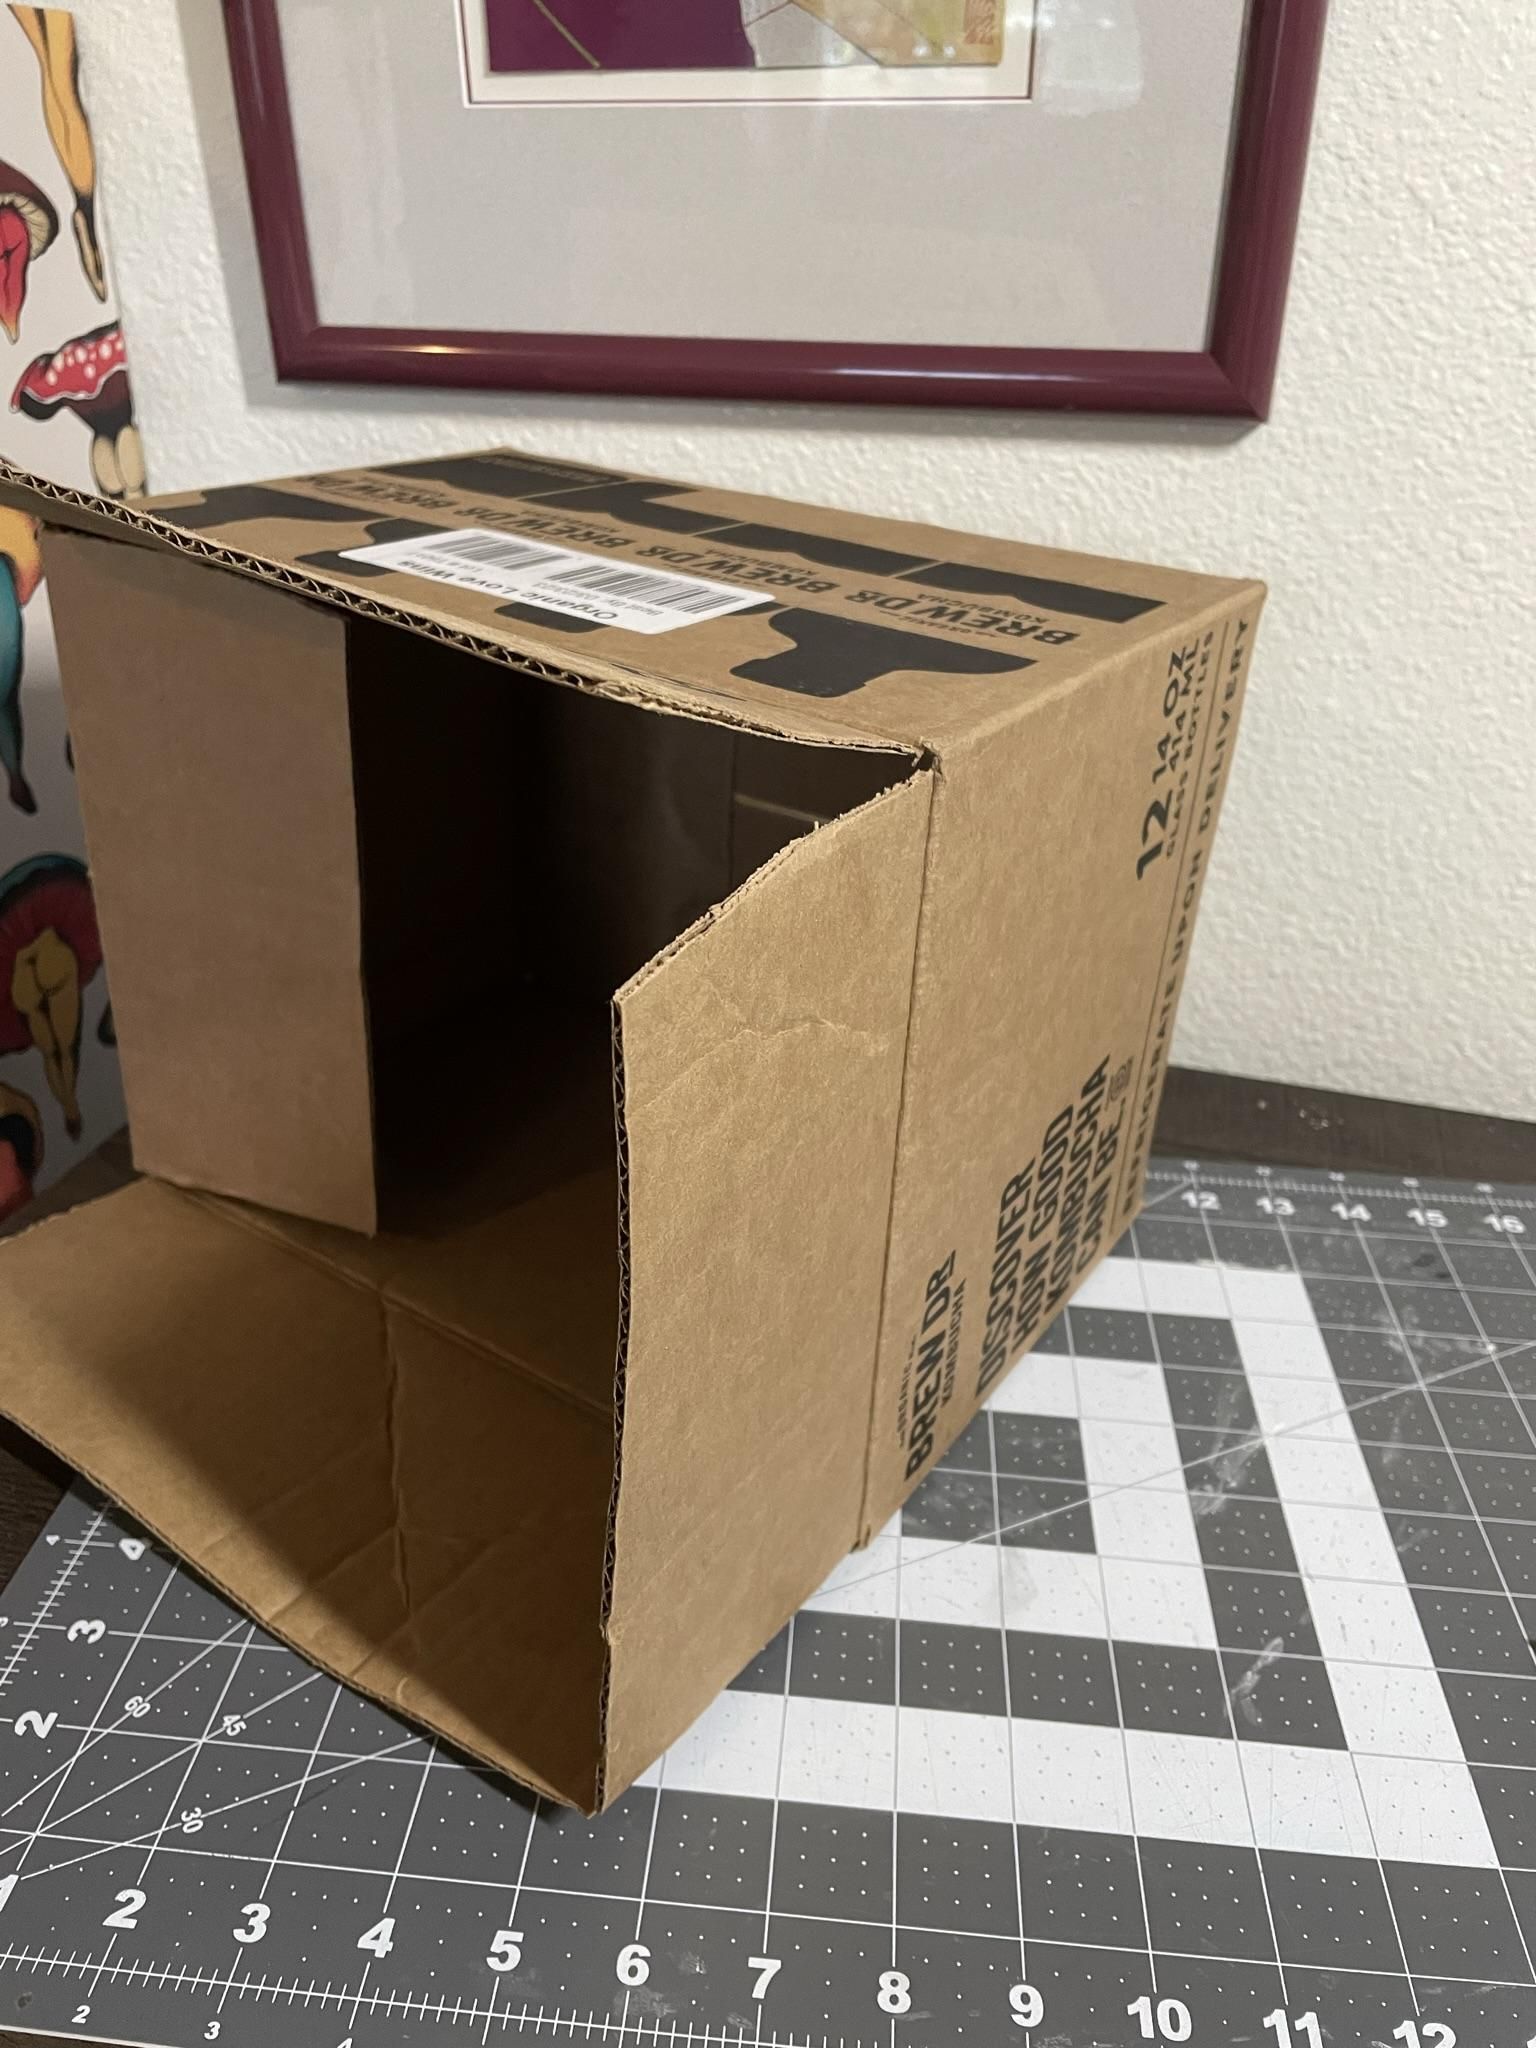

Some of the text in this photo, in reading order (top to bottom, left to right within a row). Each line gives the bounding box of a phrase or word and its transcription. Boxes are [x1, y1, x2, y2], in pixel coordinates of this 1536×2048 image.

[507, 518, 636, 550] BREW
[635, 545, 704, 564] DR
[400, 561, 456, 580] Wins
[458, 576, 518, 595] Love
[692, 559, 841, 596] BREW
[519, 592, 618, 620] Organic
[845, 590, 1081, 647] BREW DR
[916, 593, 1050, 625] KOMBUCHA
[1168, 637, 1201, 773] 414 ML
[1136, 645, 1187, 880] 12 14 OZ
[1164, 630, 1215, 859] GLASS BOTTLES
[1121, 618, 1250, 1216] REFRIGERATE UPON DELIVERY
[1042, 1054, 1111, 1315] KOMBUCHA
[1010, 1103, 1074, 1353] HOW GOOD
[1074, 1175, 1112, 1274] CAN
[1181, 1190, 1527, 1235] 12 13 14 15 16
[974, 1156, 1036, 1398] DISCOVER
[940, 1277, 968, 1409] KOMBUCHA
[903, 1249, 956, 1481] BREW DR
[67, 1618, 106, 1645] 3
[14, 1709, 59, 1740] 2
[124, 1695, 151, 1718] 60
[222, 1713, 247, 1737] 45
[180, 1806, 204, 1834] 30
[102, 1888, 147, 1930] 2
[233, 1903, 272, 1944] 3
[357, 1917, 397, 1960] 4
[486, 1930, 524, 1972] 5
[616, 1944, 651, 1986] 6
[748, 1957, 782, 1999] 7
[877, 1970, 912, 2014] 8
[1008, 1984, 1044, 2028] 9
[1127, 1995, 1193, 2043] 10
[1263, 2008, 1324, 2048] 11
[71, 2004, 91, 2025] 2
[203, 2021, 222, 2040] 3
